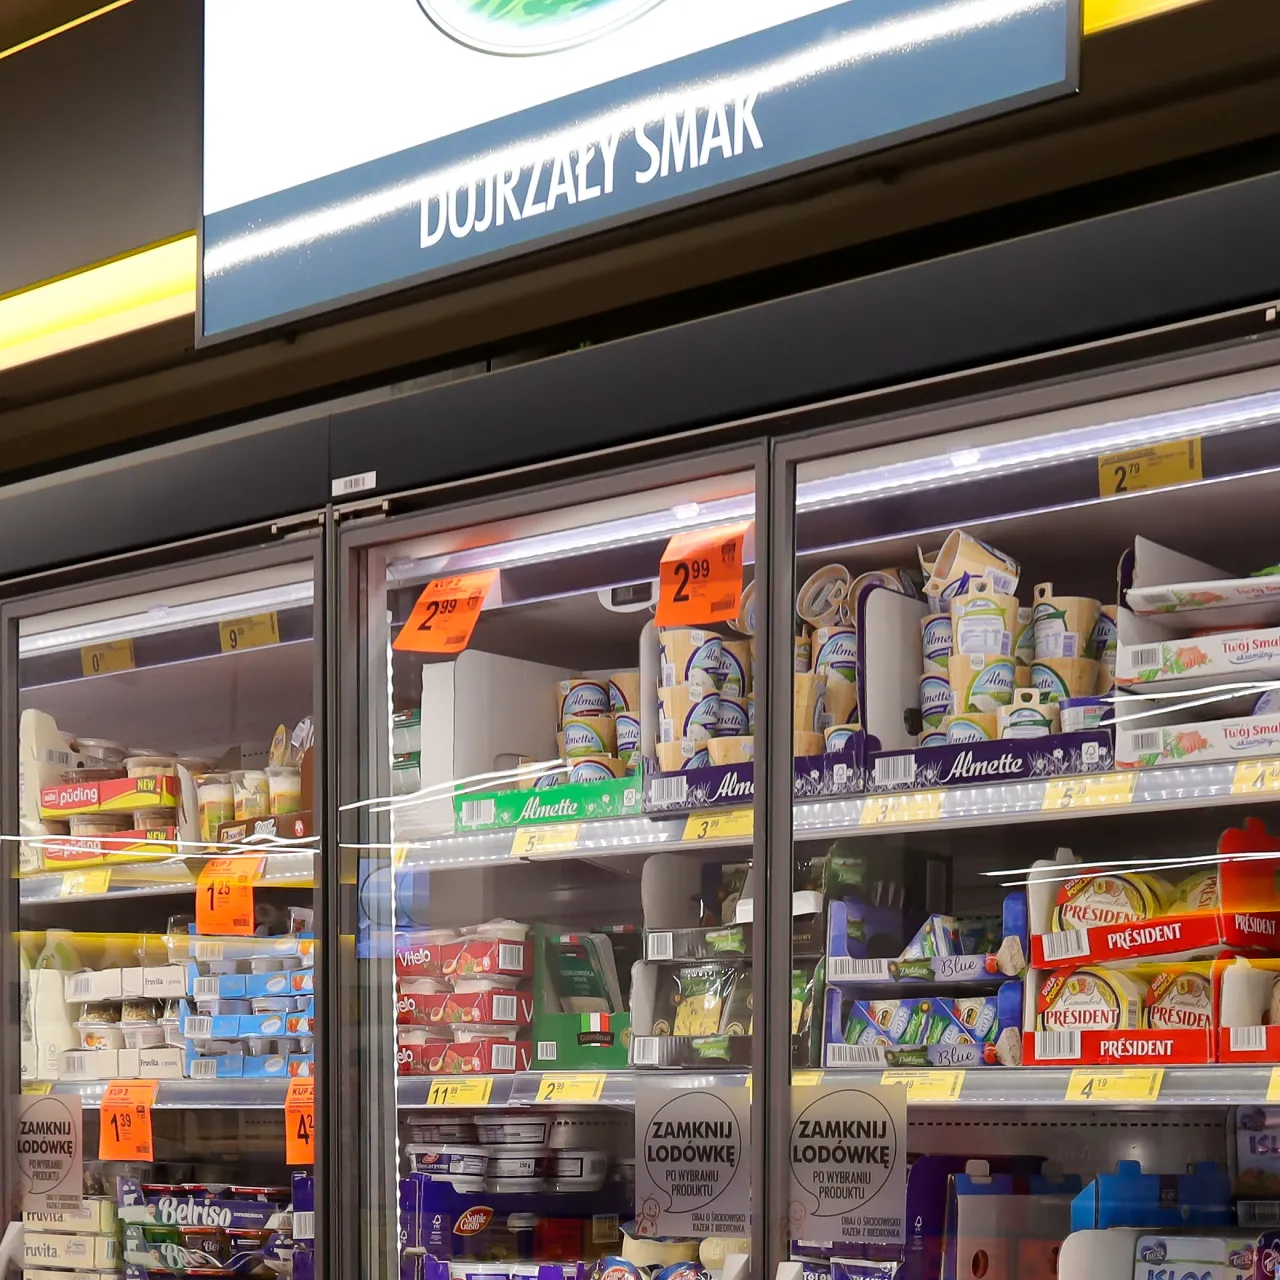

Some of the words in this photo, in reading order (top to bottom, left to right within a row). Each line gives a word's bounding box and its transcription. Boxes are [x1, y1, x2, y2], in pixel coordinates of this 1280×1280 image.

[635, 90, 764, 182] SMAK
[673, 563, 689, 603] 2
[691, 560, 710, 578] 99
[418, 601, 439, 630] 2
[439, 599, 457, 614] 99
[1222, 638, 1247, 653] Twój
[1223, 725, 1247, 740] Twój
[941, 749, 1024, 782] Almette
[137, 779, 155, 792] NEW
[60, 786, 98, 805] püding
[518, 797, 577, 824] Almette
[206, 882, 215, 911] 1
[217, 881, 230, 896] 25
[1108, 925, 1181, 948] PRÉSIDENT
[940, 956, 977, 975] Blue
[1045, 1007, 1117, 1025] PRÉSIDENT
[937, 1046, 974, 1065] Blue
[1100, 1038, 1173, 1057] PRÉSIDENT
[20, 1121, 71, 1136] ZAMKNIJ
[111, 1112, 119, 1143] 1
[120, 1113, 131, 1128] 39
[652, 1122, 732, 1139] ZAMKNIJ
[799, 1118, 887, 1140] ZAMKNIJ
[18, 1139, 73, 1156] LODÓWKĘ
[648, 1141, 735, 1167] LODÓWKĘ
[793, 1141, 889, 1170] LODÓWKĘ
[665, 1170, 675, 1181] PO
[679, 1170, 718, 1182] WYBRANIU
[812, 1172, 825, 1183] PO
[829, 1172, 871, 1185] WYBRANIU
[672, 1184, 713, 1197] PRODUKTU
[818, 1185, 865, 1199] PRODUKTU
[161, 1196, 231, 1226] Belriso
